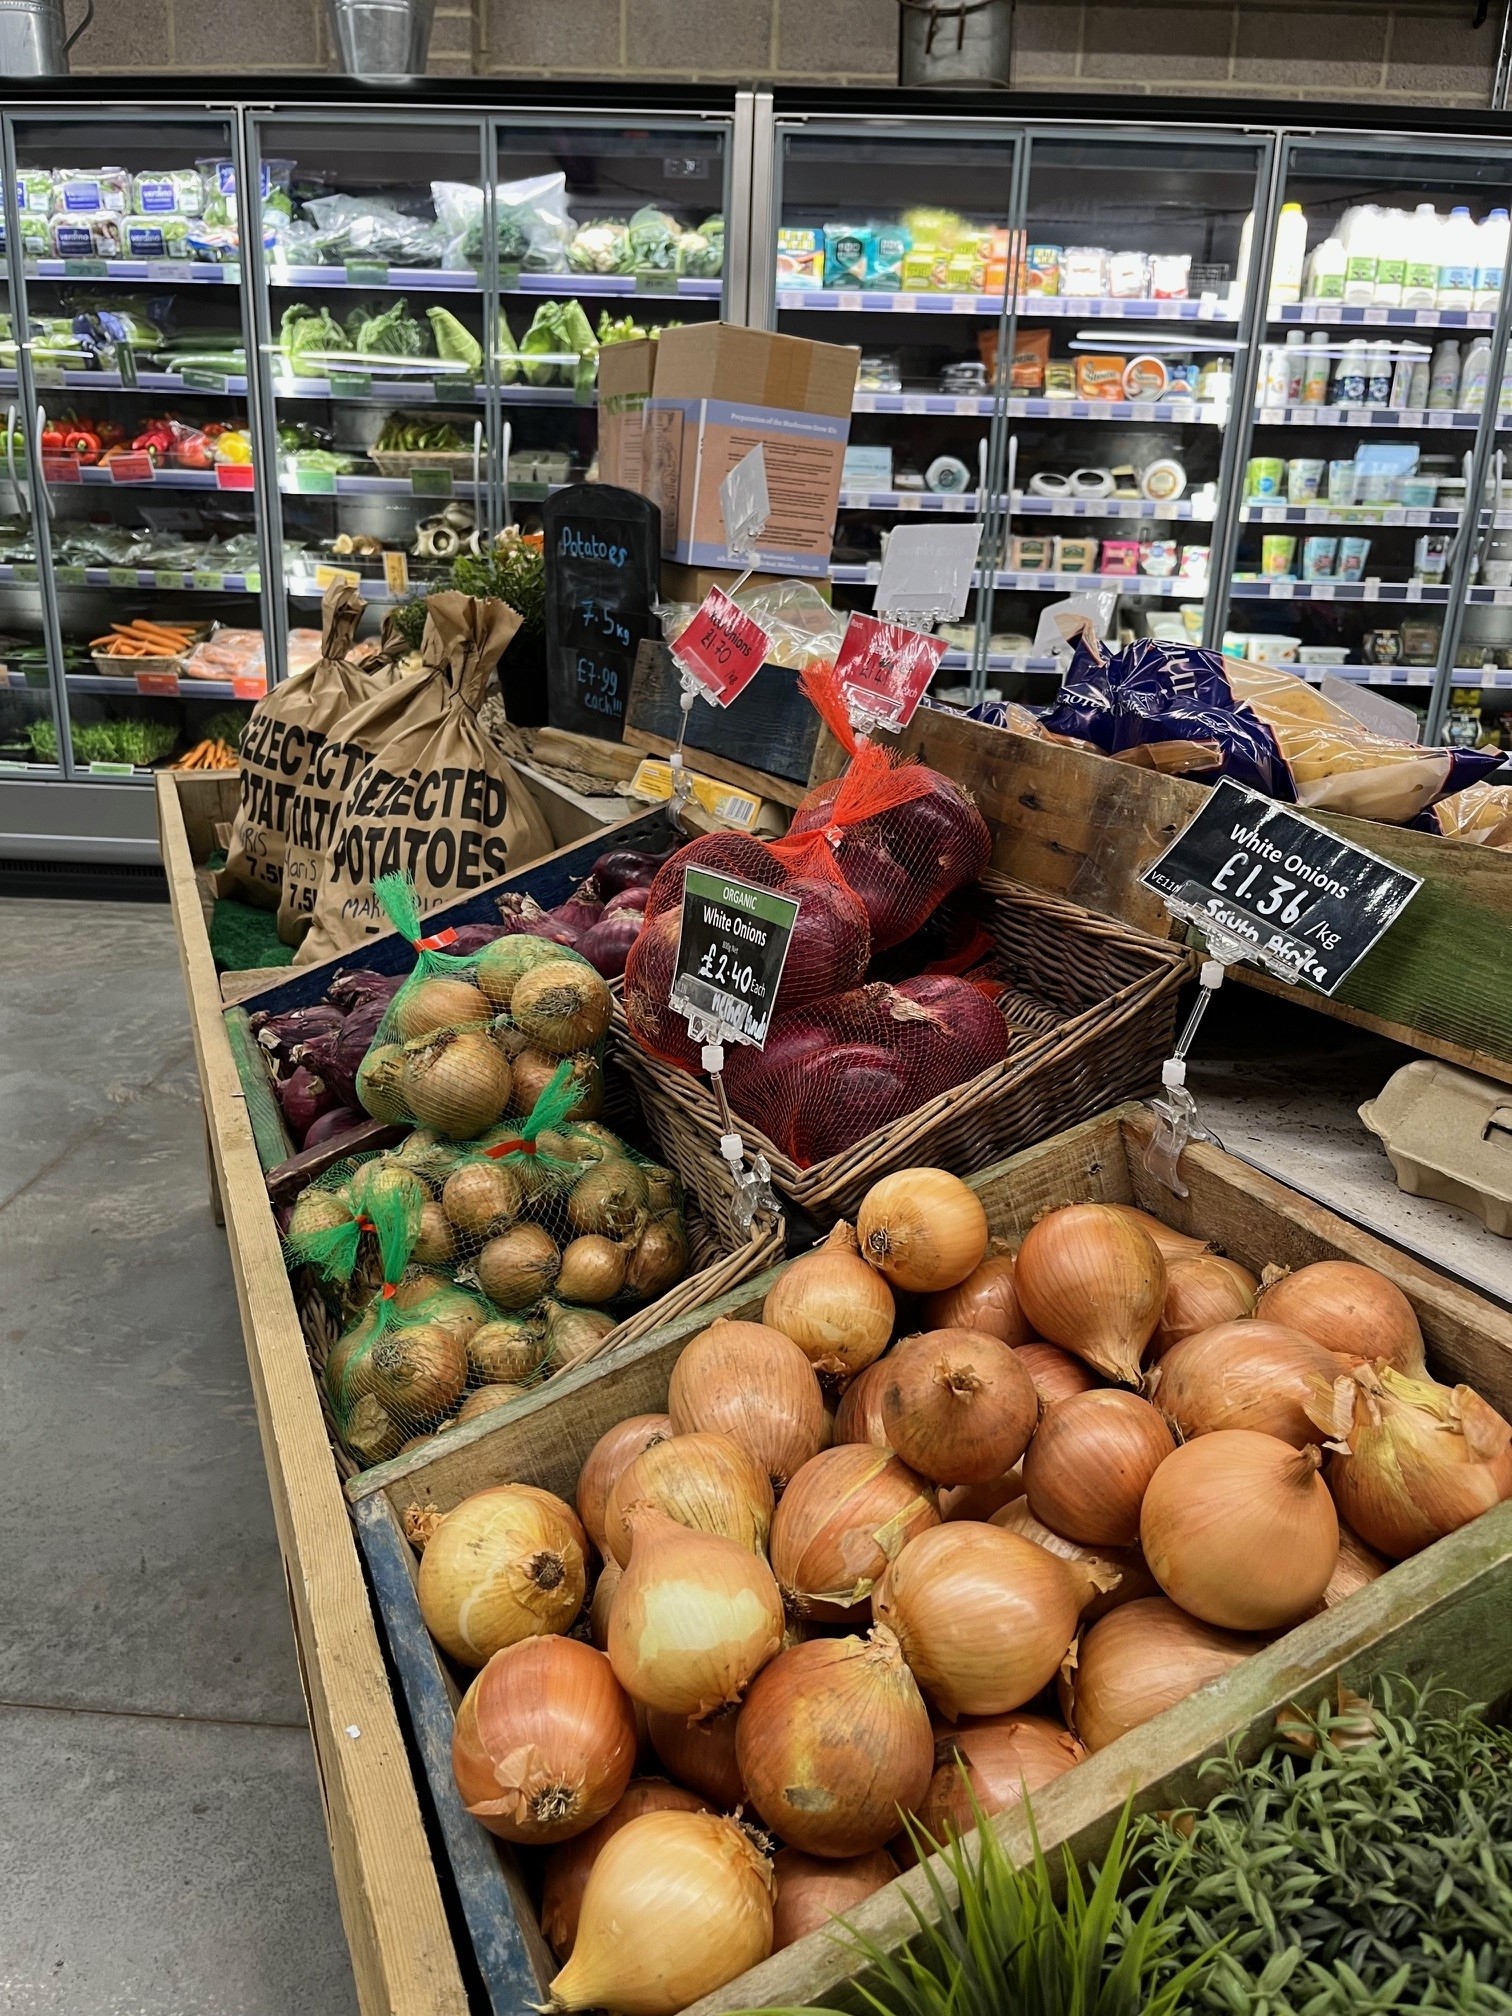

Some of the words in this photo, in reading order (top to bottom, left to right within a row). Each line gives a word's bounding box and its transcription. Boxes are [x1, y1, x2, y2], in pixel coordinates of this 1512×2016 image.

[561, 525, 628, 568] Potatoes
[346, 766, 508, 829] SELECTED
[331, 824, 508, 889] POTATOES
[1229, 822, 1281, 864] White
[1283, 854, 1350, 901] Onions
[723, 886, 758, 911] ORGANIC
[703, 904, 732, 933] White
[733, 917, 768, 947] Onions
[1303, 920, 1342, 951] /kg
[698, 943, 753, 994] £2.40
[750, 978, 766, 998] Each
